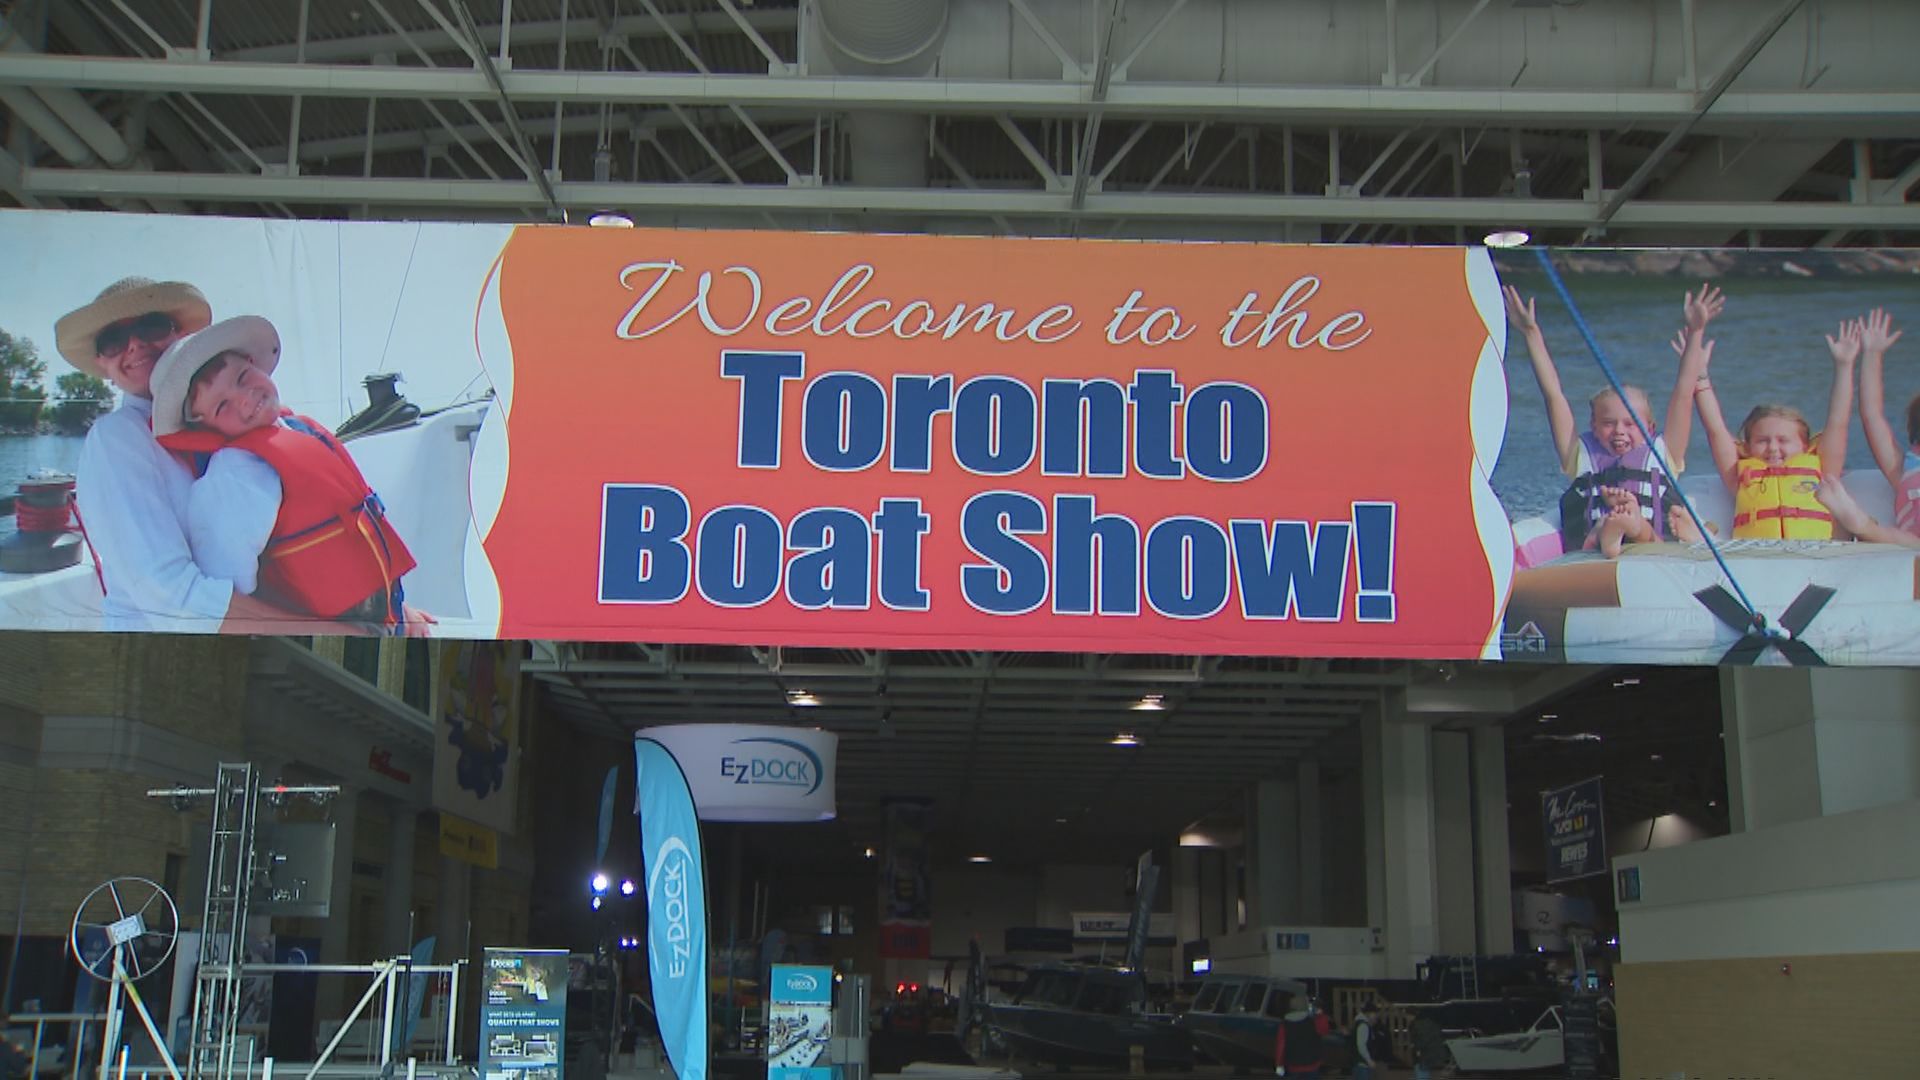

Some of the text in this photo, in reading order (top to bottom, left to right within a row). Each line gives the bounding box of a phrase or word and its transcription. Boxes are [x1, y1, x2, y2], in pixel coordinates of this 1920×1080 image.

[615, 259, 1374, 350] Welcome to the
[719, 349, 1270, 482] Toronto
[597, 483, 1397, 625] Boat Show!
[487, 1019, 518, 1027] QUALITY
